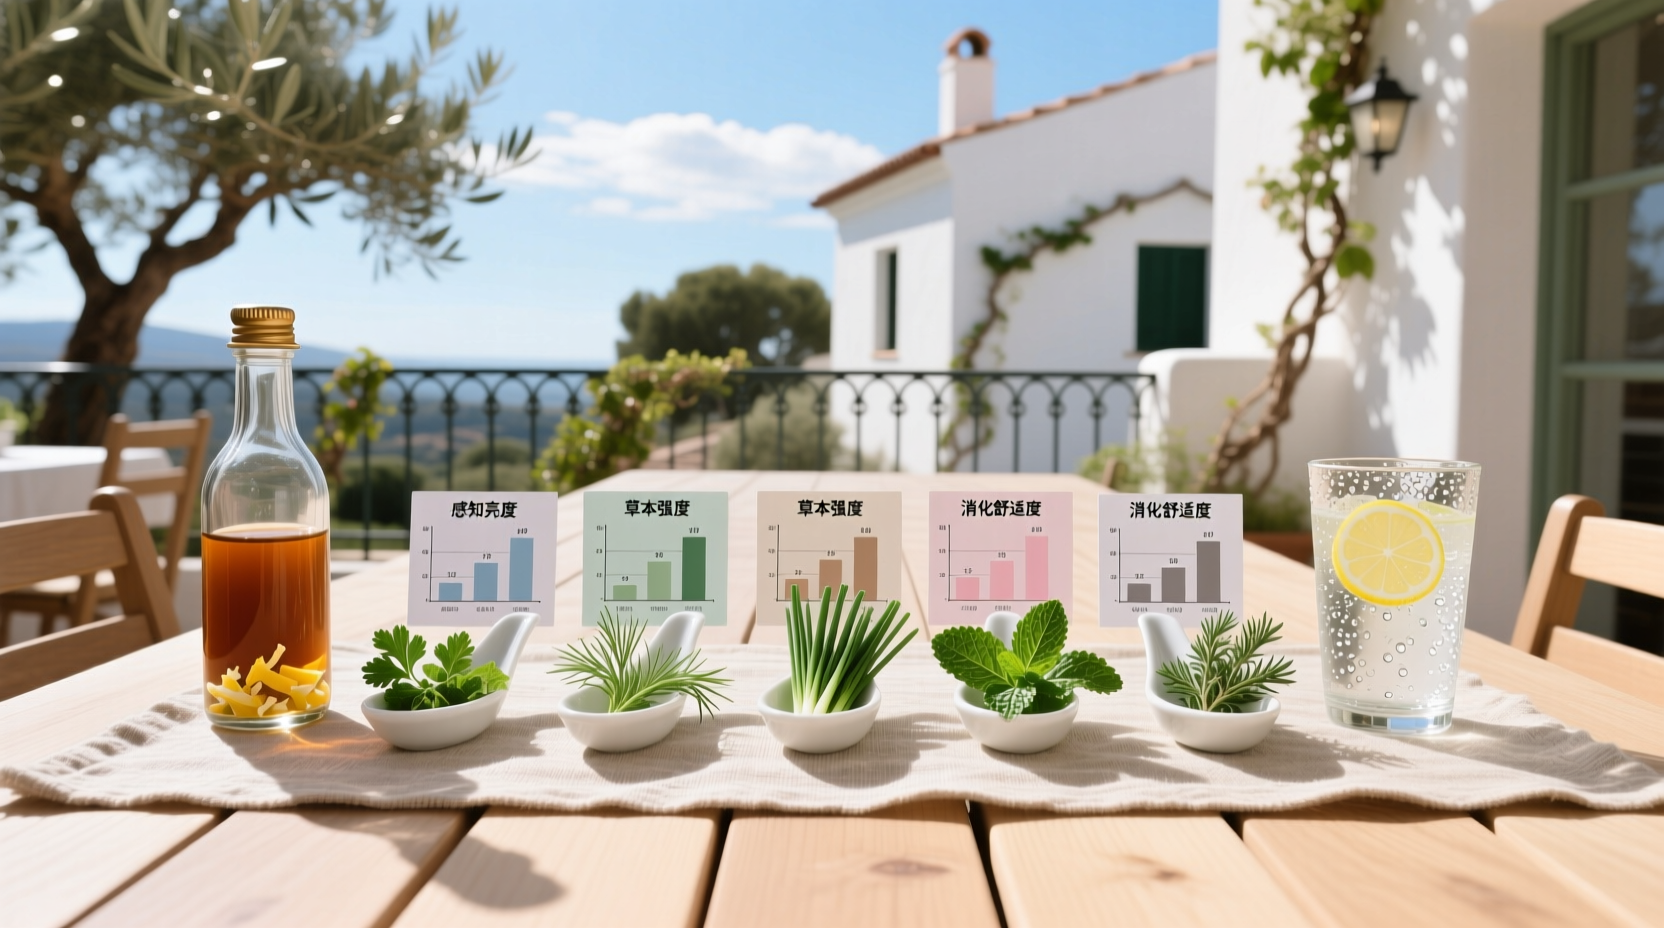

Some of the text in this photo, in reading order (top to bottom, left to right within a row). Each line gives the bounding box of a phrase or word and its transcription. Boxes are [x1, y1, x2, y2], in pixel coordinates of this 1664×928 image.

[452, 501, 518, 518] 感知亮度
[625, 499, 690, 517] 草本强度
[797, 499, 863, 517] 草本强度
[961, 499, 1041, 517] 消化舒适度
[1130, 501, 1212, 519] 消化舒适度
